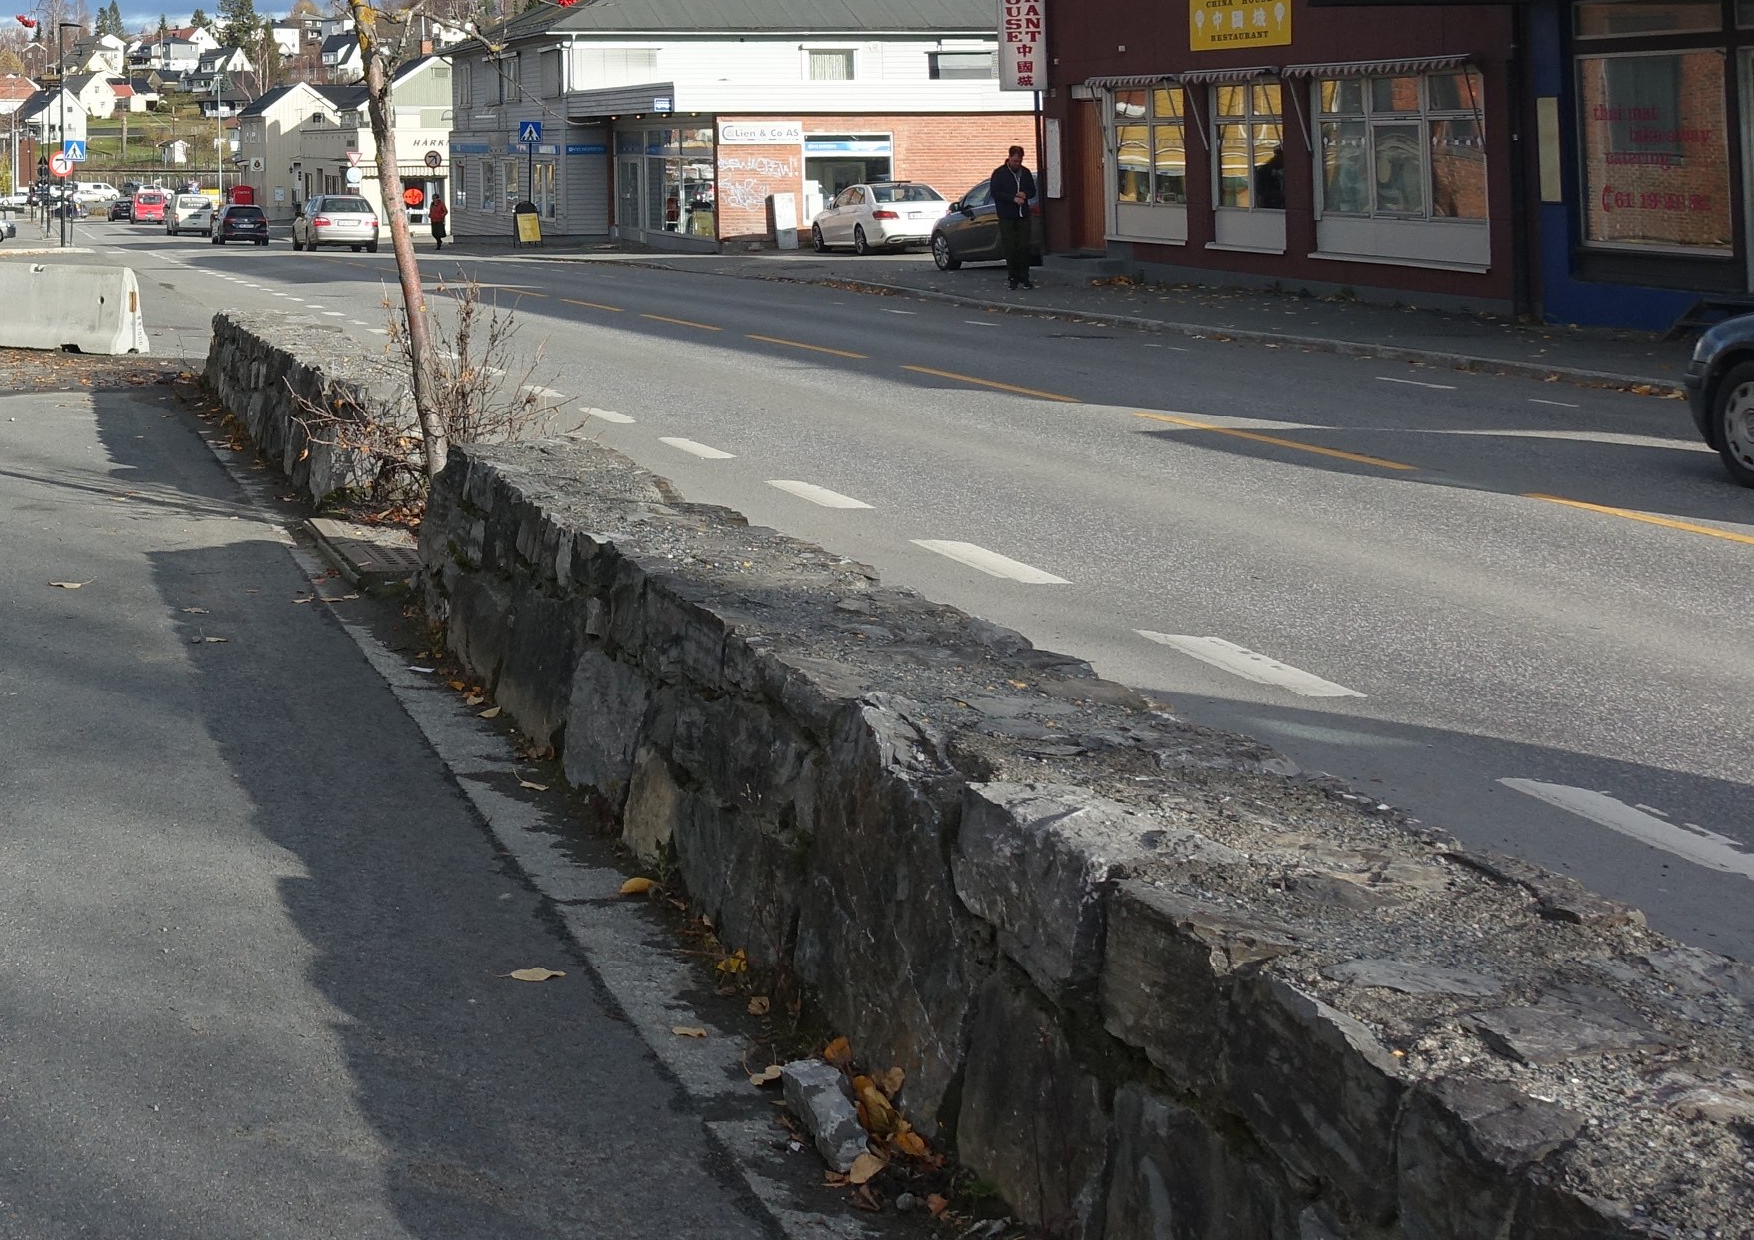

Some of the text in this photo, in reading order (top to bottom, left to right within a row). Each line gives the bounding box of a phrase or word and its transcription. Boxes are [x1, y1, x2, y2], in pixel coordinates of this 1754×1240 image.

[1206, 0, 1233, 8] CHINA
[1210, 31, 1269, 42] RESTAURANT
[735, 129, 756, 137] Lien
[759, 129, 767, 137] &
[770, 129, 783, 137] Co
[786, 129, 799, 137] AS
